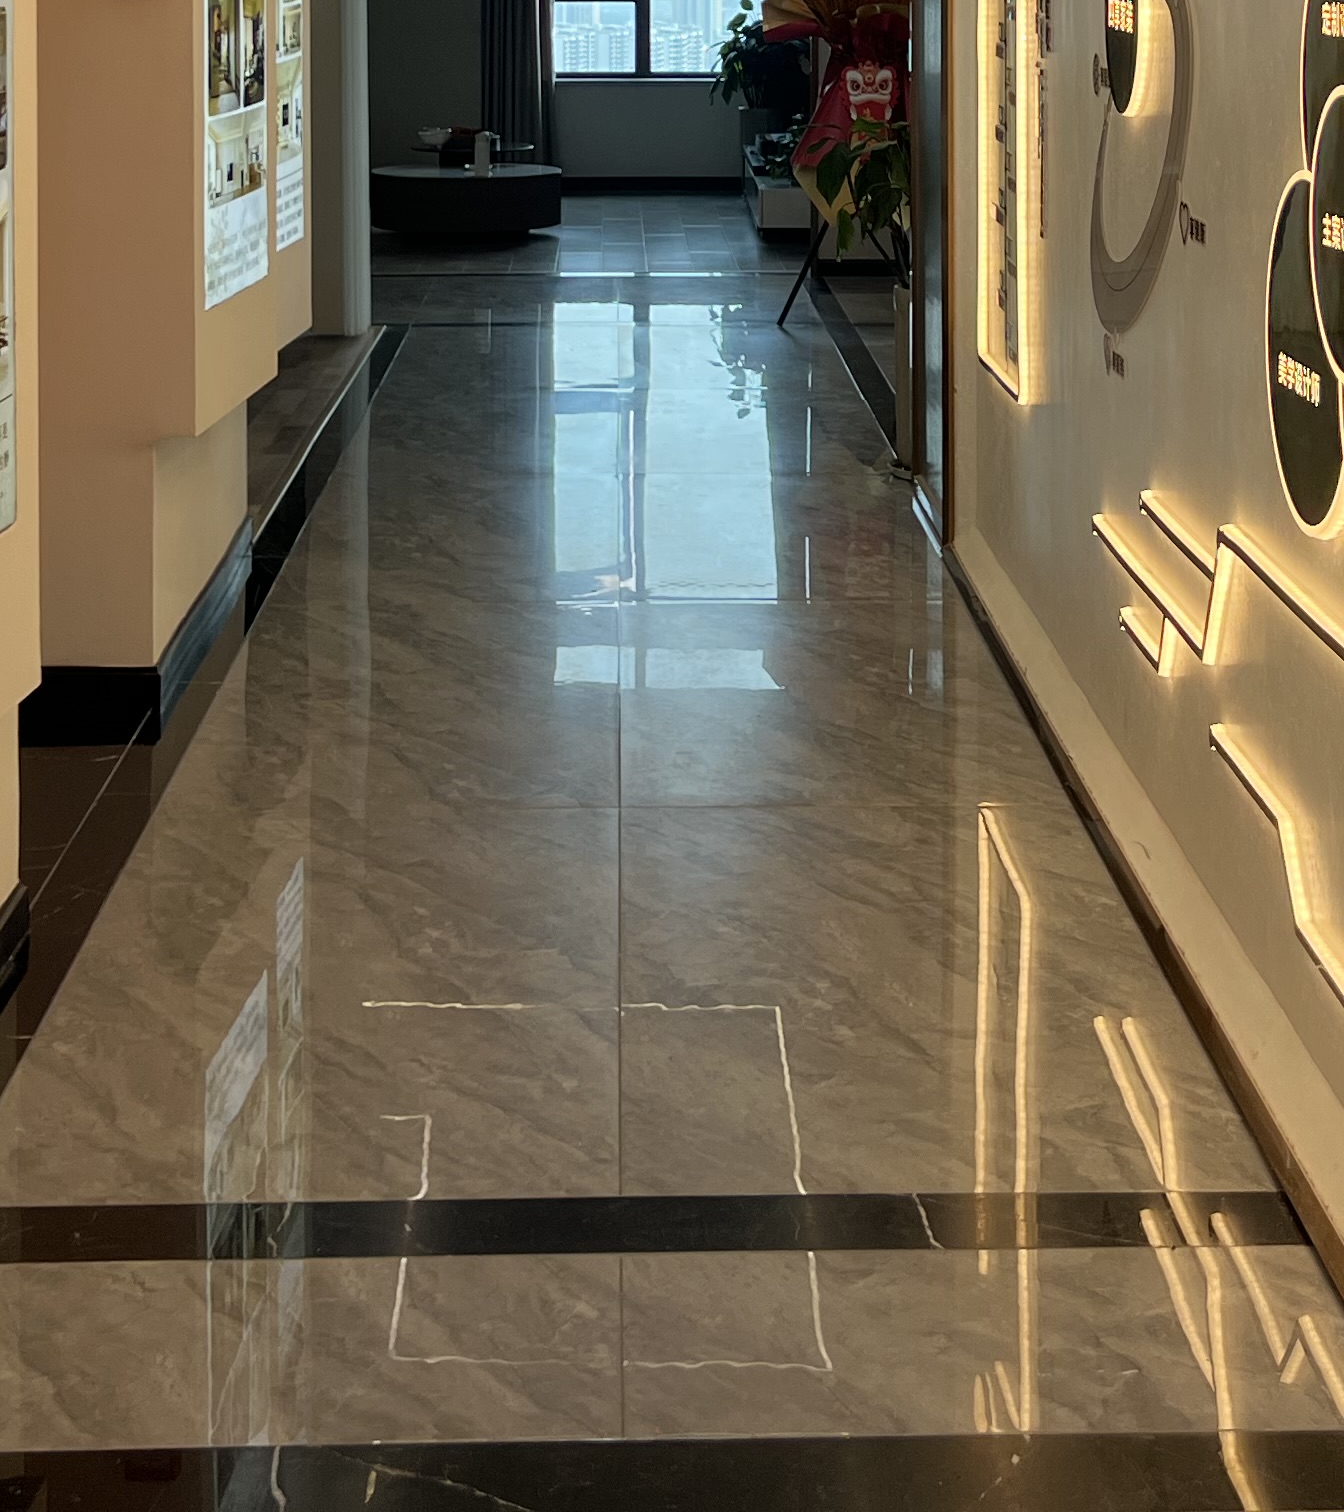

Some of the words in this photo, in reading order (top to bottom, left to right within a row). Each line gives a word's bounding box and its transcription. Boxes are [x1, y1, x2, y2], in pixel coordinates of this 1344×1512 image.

[1277, 352, 1321, 408] 美学设计师
